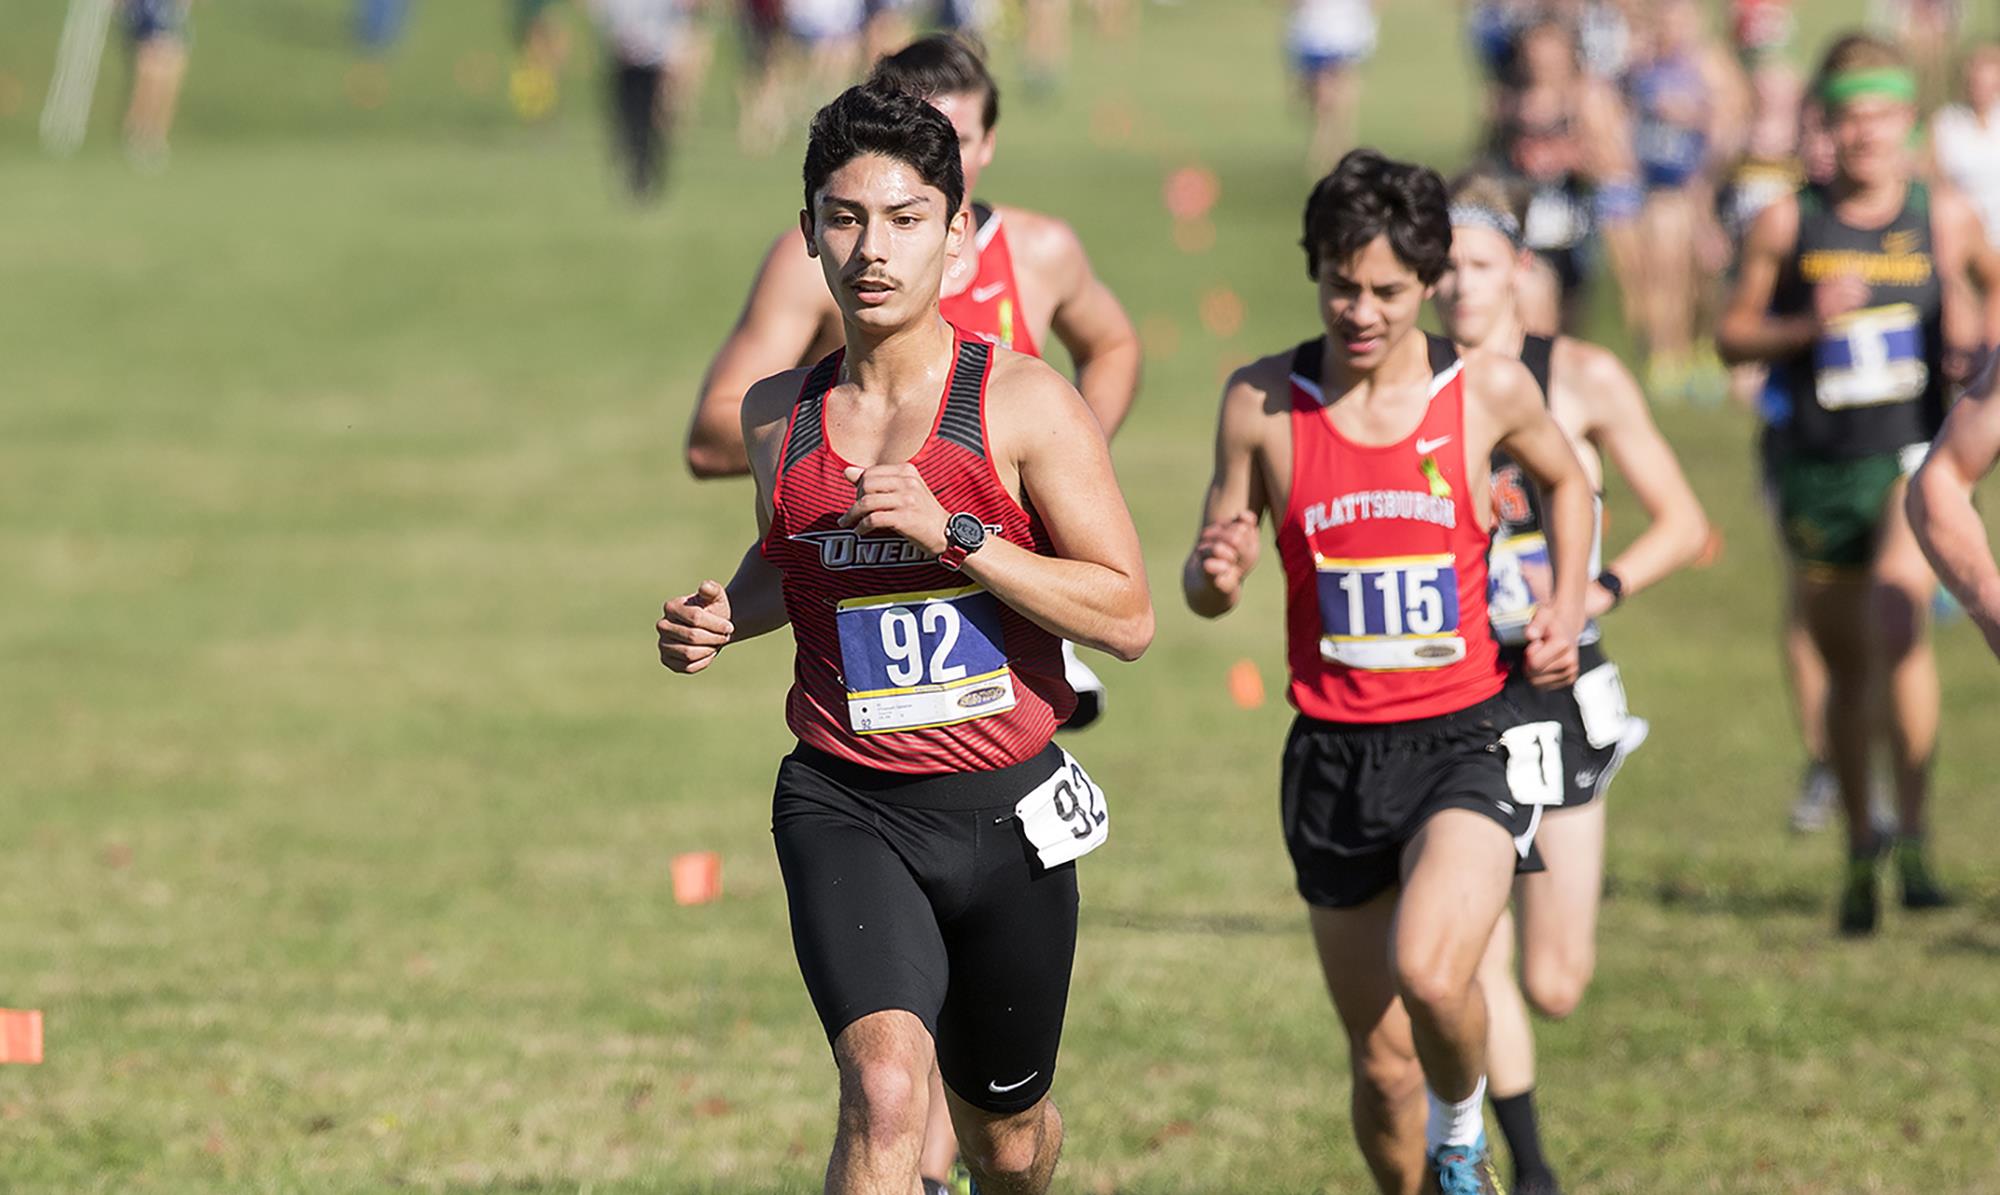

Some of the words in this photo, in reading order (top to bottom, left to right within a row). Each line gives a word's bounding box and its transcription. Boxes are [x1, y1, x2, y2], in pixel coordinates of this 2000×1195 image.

[1304, 490, 1456, 536] PLATTSBURGH
[1339, 569, 1444, 637] 115
[880, 602, 967, 687] 92
[1053, 763, 1106, 840] 92
